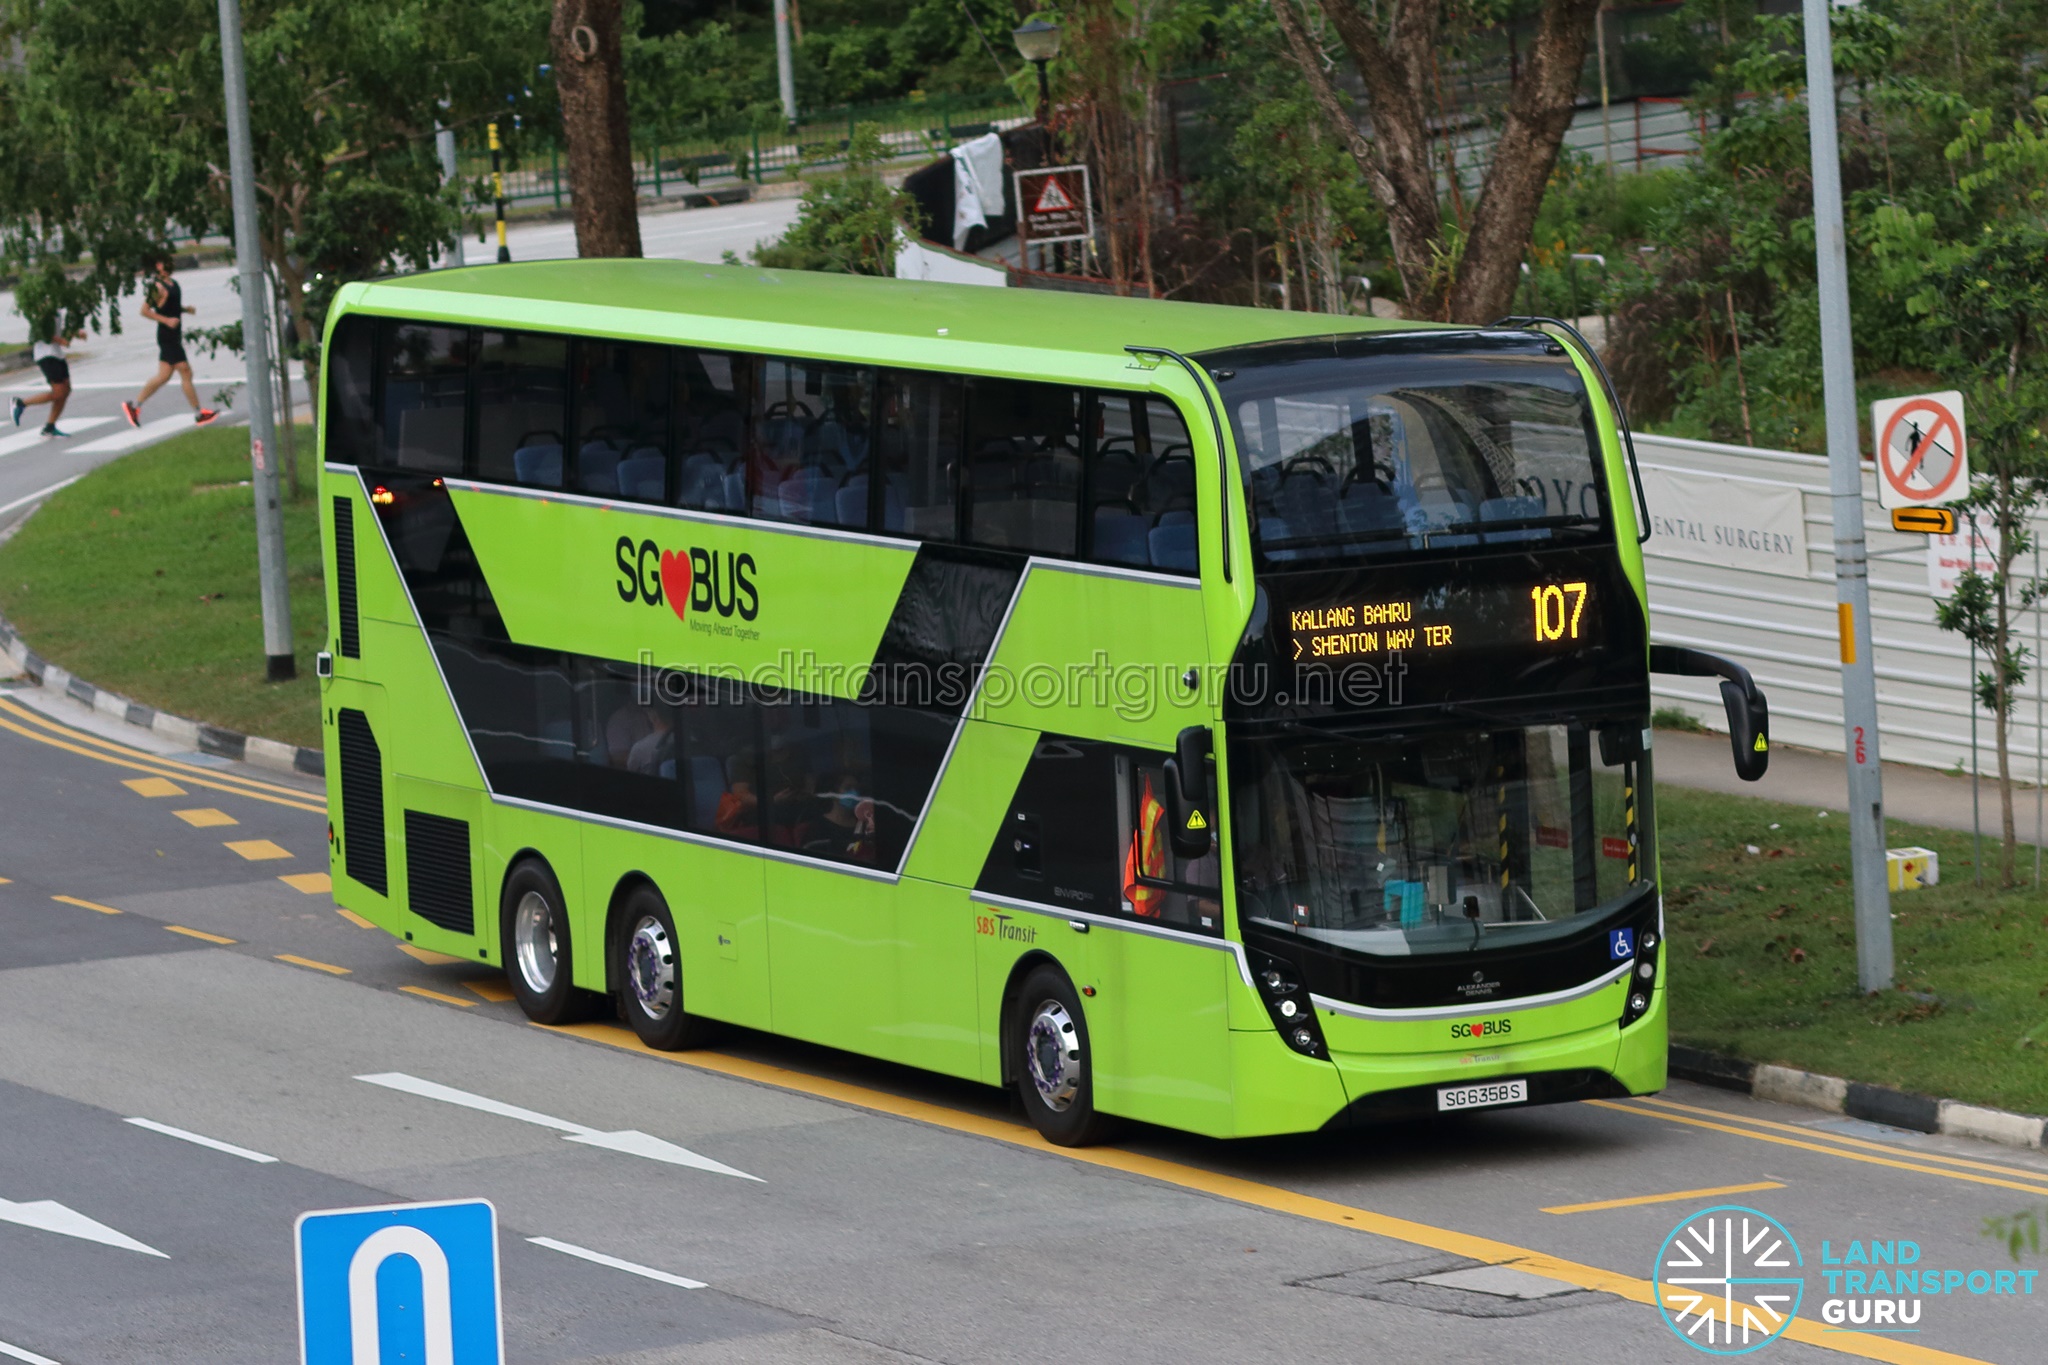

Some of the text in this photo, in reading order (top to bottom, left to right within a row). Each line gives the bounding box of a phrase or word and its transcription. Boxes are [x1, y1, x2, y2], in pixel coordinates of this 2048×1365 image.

[1643, 514, 1794, 555] ENTAL SURGERY
[1292, 602, 1411, 631] KALLANG BAHRU
[1531, 582, 1587, 642] 107
[1312, 625, 1453, 657] SHENTON WAY TER
[976, 913, 1038, 943] SBS Transit
[1457, 981, 1500, 991] ALEXANDER
[1445, 1084, 1521, 1107] SG6358S
